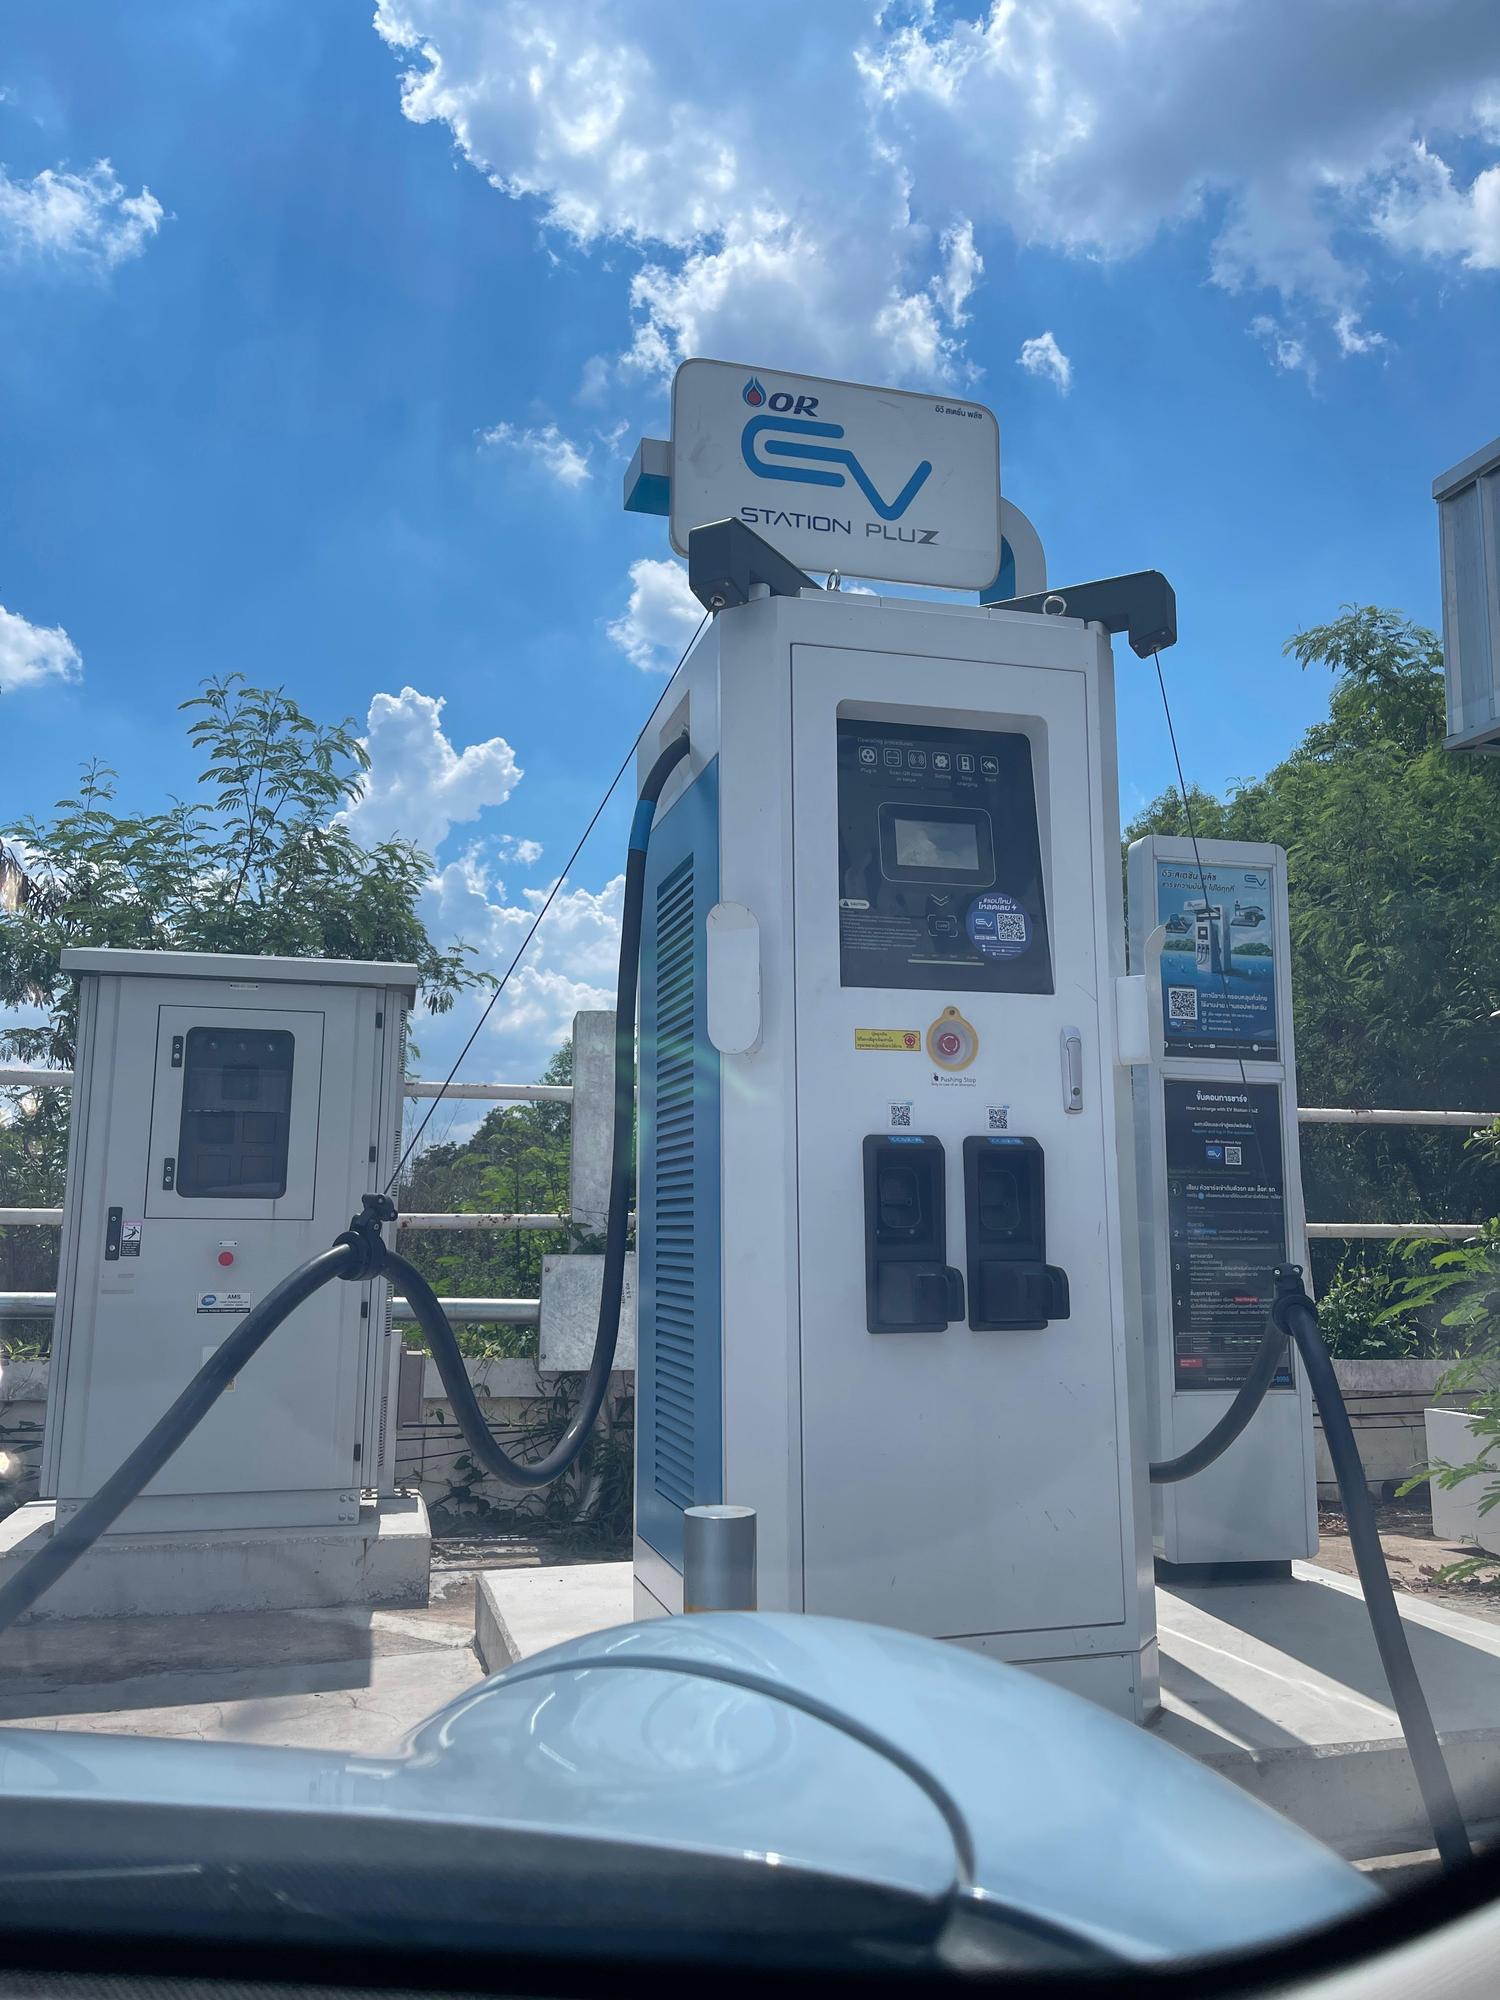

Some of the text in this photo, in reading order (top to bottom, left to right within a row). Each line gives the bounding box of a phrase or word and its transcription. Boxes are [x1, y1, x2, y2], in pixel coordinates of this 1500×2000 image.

[768, 392, 819, 417] OR
[741, 414, 932, 521] EV
[741, 506, 851, 534] STATION
[940, 1076, 977, 1084] Pushing Stop
[1175, 1263, 1180, 1271] 3
